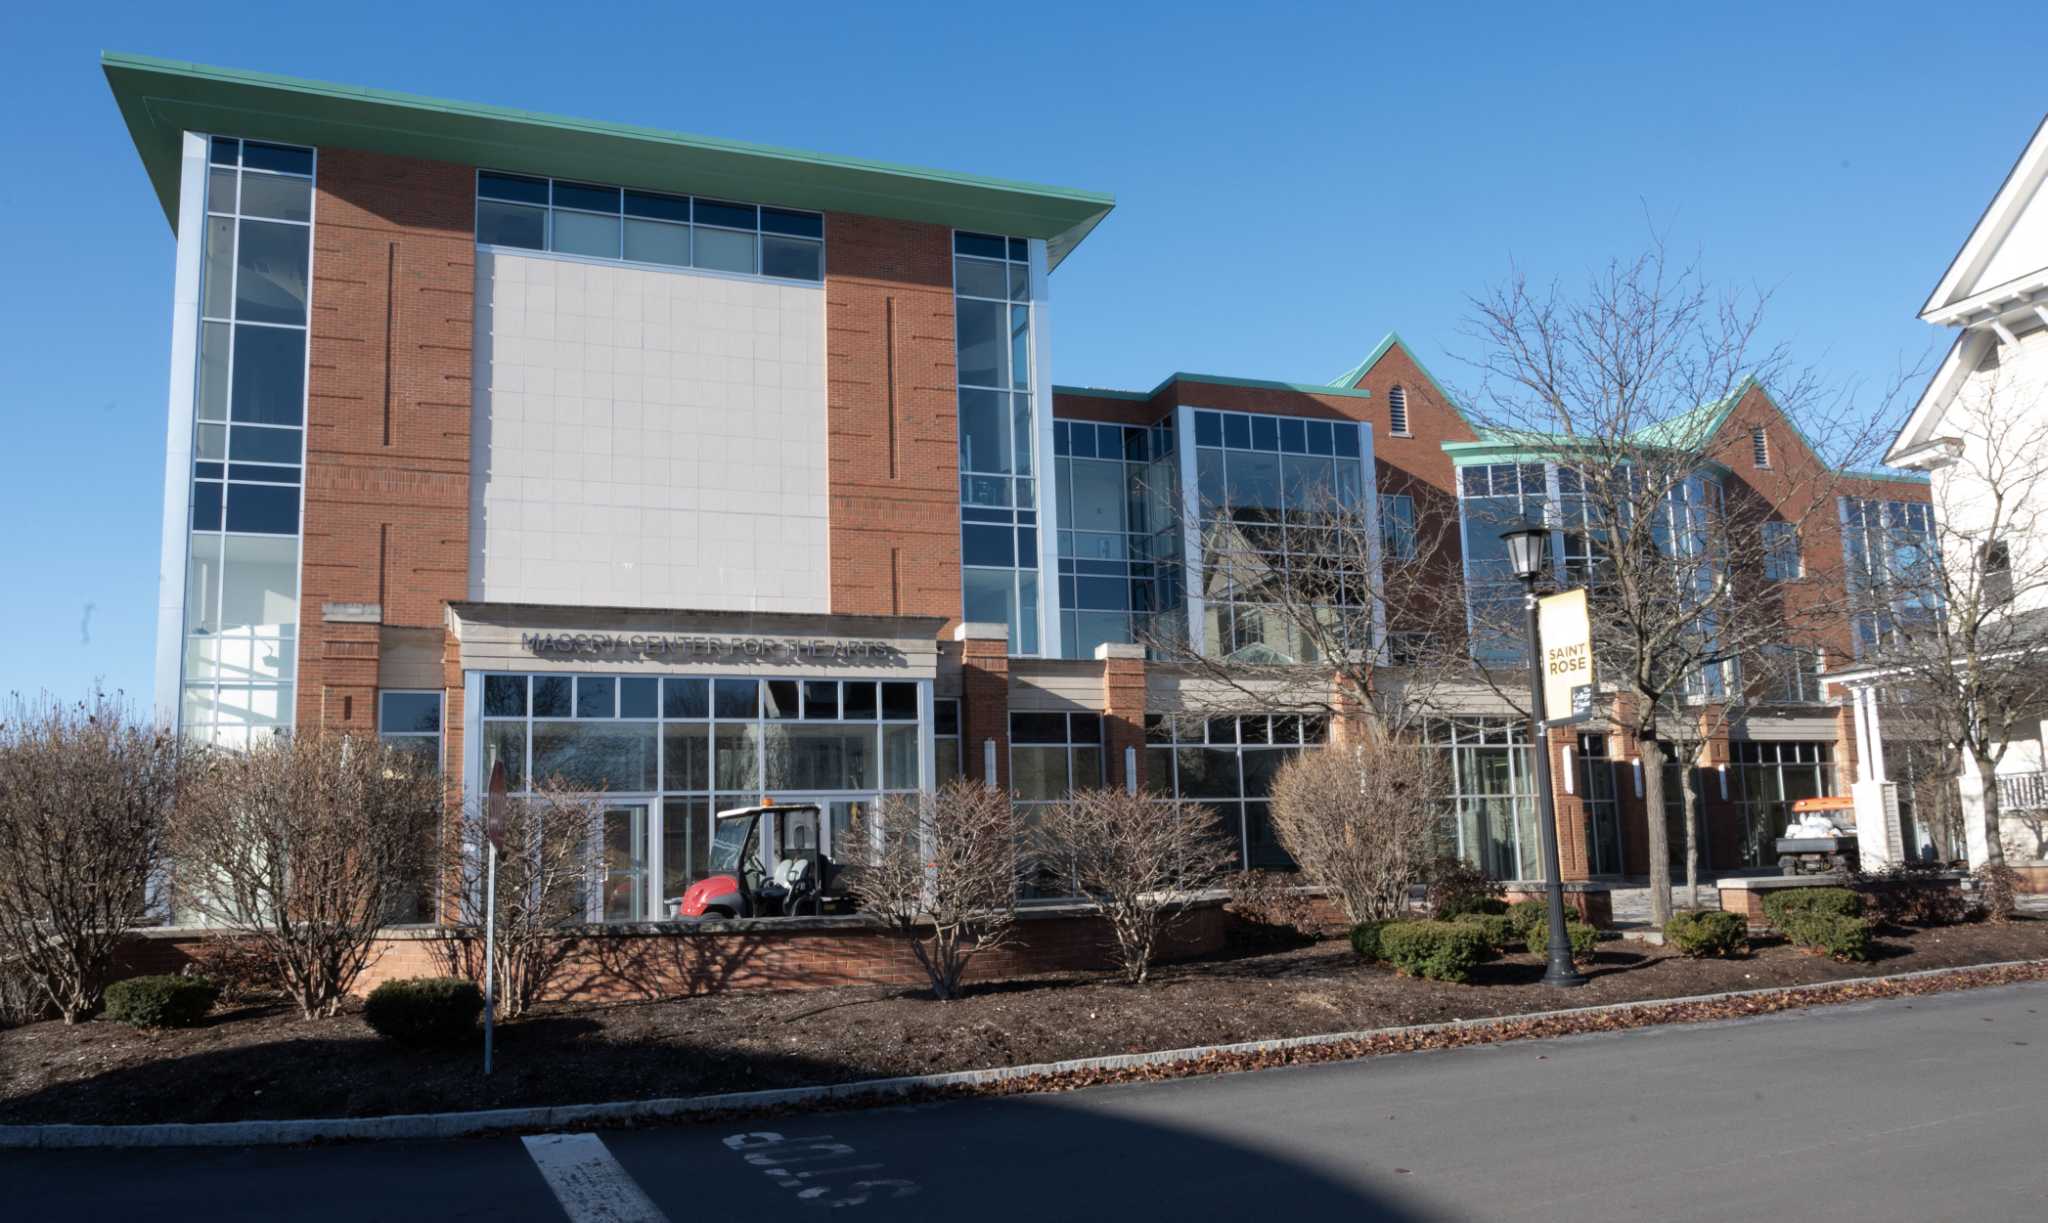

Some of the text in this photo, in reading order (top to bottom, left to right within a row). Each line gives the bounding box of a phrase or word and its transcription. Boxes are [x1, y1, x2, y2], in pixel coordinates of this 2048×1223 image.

[522, 632, 888, 657] MASSRY CENTER FOR THE ARTS
[1549, 643, 1585, 660] SAINT
[1550, 657, 1586, 675] ROSE
